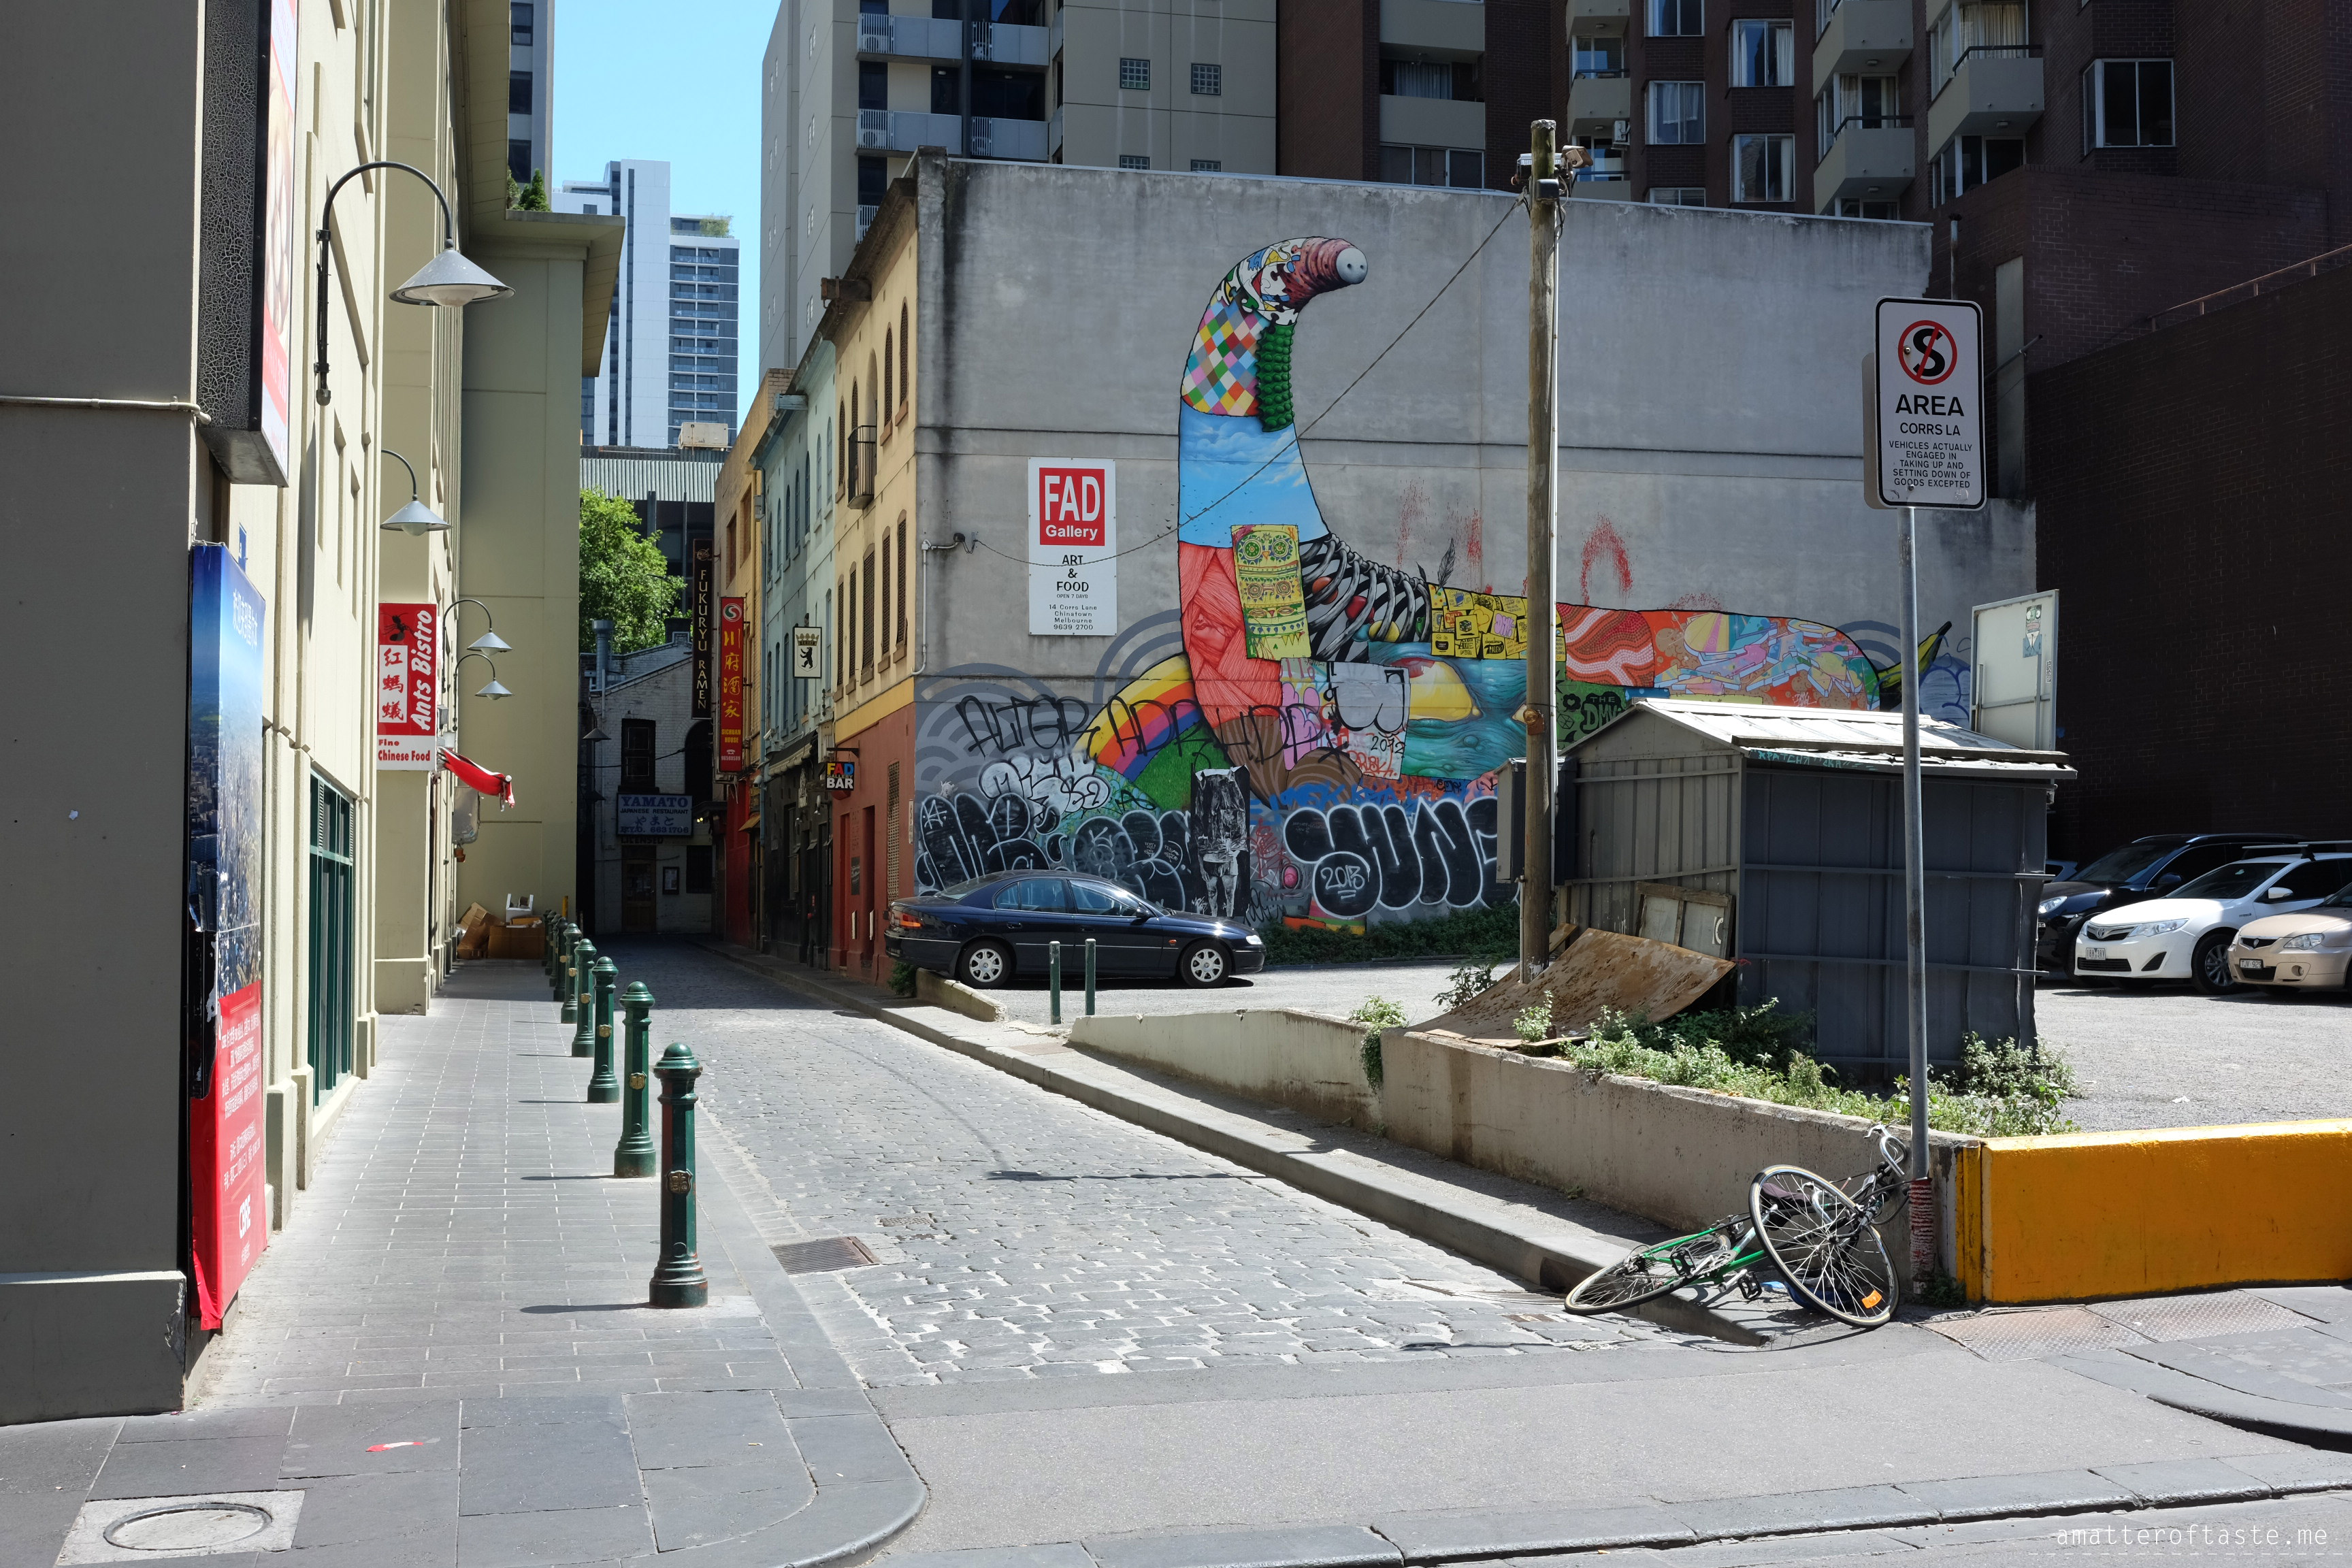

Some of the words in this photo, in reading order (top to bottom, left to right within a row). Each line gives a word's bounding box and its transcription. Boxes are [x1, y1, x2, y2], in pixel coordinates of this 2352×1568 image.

[1895, 394, 1965, 416] AREA
[1900, 422, 1943, 435] CORRS
[1946, 424, 1961, 436] LA
[1889, 441, 1929, 450] VEHICLES
[1933, 443, 1972, 452] ACTUALLY
[1906, 451, 1945, 459] ENGAGED
[1900, 460, 1930, 468] TAKING
[1933, 461, 1944, 469] UP
[1947, 461, 1963, 470] AND
[1893, 469, 1928, 478] SETTING
[1931, 470, 1957, 478] DOWN
[1960, 471, 1971, 479] OF
[1894, 478, 1925, 487] GOODS
[1928, 479, 1970, 488] EXCEPTED
[1045, 475, 1100, 521] FAD
[1045, 525, 1098, 540] Gallery
[1062, 555, 1083, 565] ART
[1068, 568, 1077, 578] &
[1056, 581, 1089, 591] FOOD
[698, 570, 708, 651] FUKURYU
[411, 610, 432, 676] Bistro
[697, 660, 708, 709] RAMEN
[410, 679, 431, 731] Ants
[1371, 736, 1405, 754] 2012
[378, 750, 409, 761] Chinese
[411, 750, 430, 761] Food
[827, 763, 854, 775] FAD
[826, 778, 853, 789] BAR
[621, 796, 688, 808] YAMATO
[1321, 864, 1365, 889] 2013
